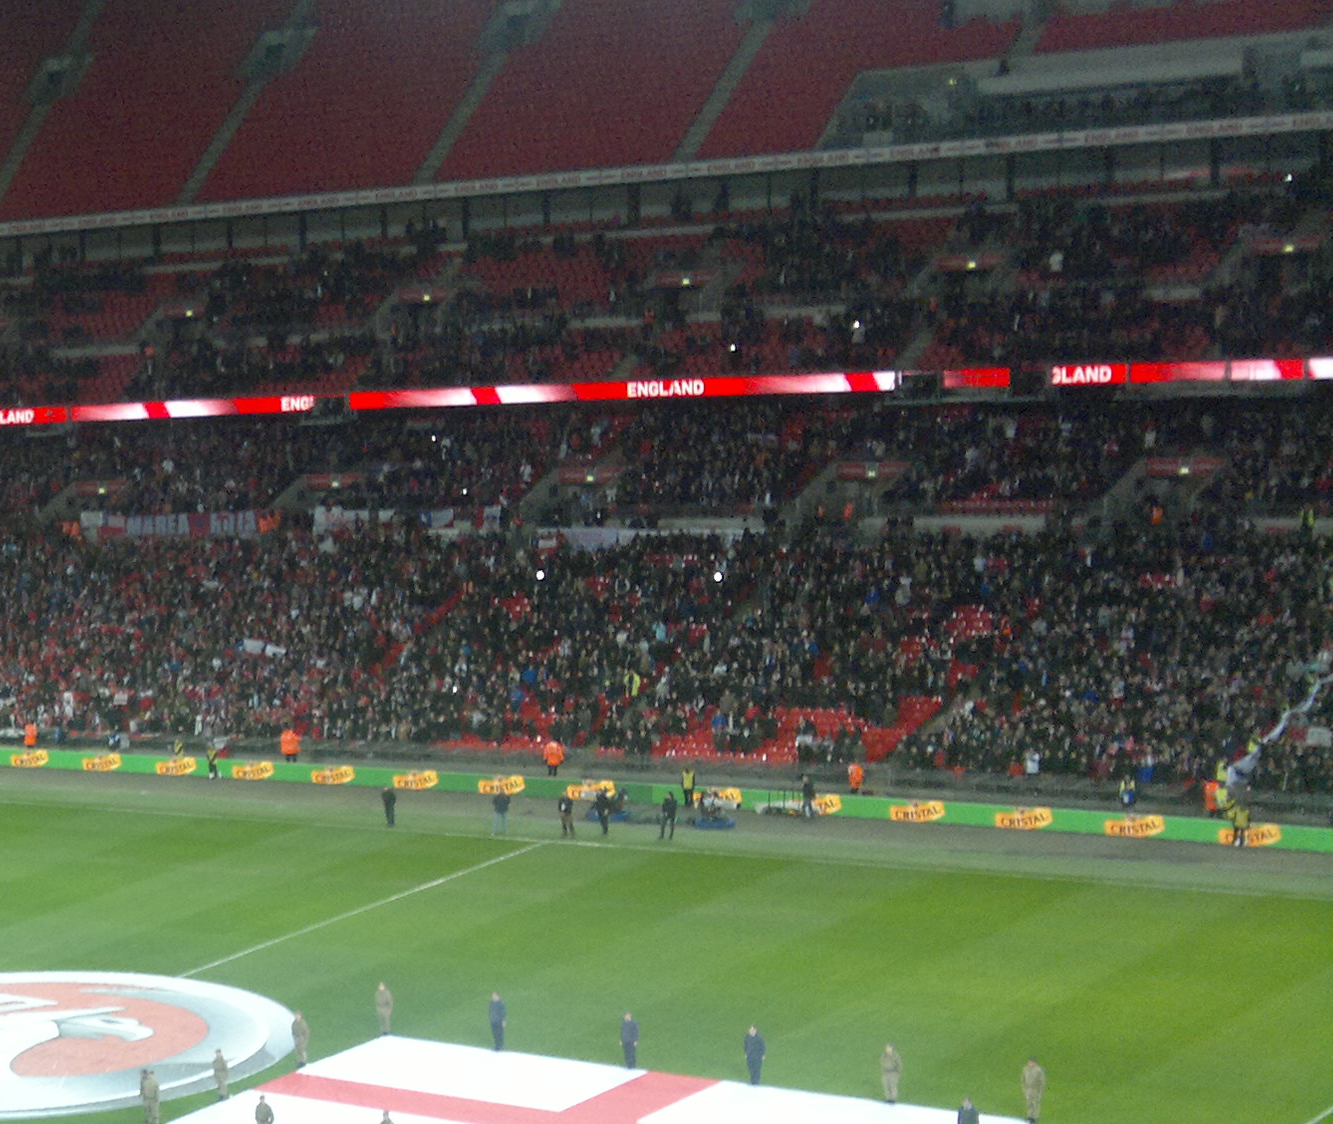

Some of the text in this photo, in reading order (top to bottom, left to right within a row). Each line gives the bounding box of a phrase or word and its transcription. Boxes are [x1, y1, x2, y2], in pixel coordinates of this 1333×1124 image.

[627, 379, 704, 398] ENGLAND
[1052, 365, 1112, 384] GLAND
[14, 753, 46, 767] CRISTAL
[85, 757, 118, 770] CRISTAL
[159, 760, 194, 775] CRISTAL
[236, 765, 271, 778] CRISTAL
[315, 768, 352, 783] CRISTAL
[397, 774, 435, 789] CRISTAL
[483, 781, 521, 793] CRISTAL
[894, 806, 940, 820] CRISTAL
[1000, 811, 1049, 827] CRISTAL
[1110, 819, 1160, 835] CRISTAL
